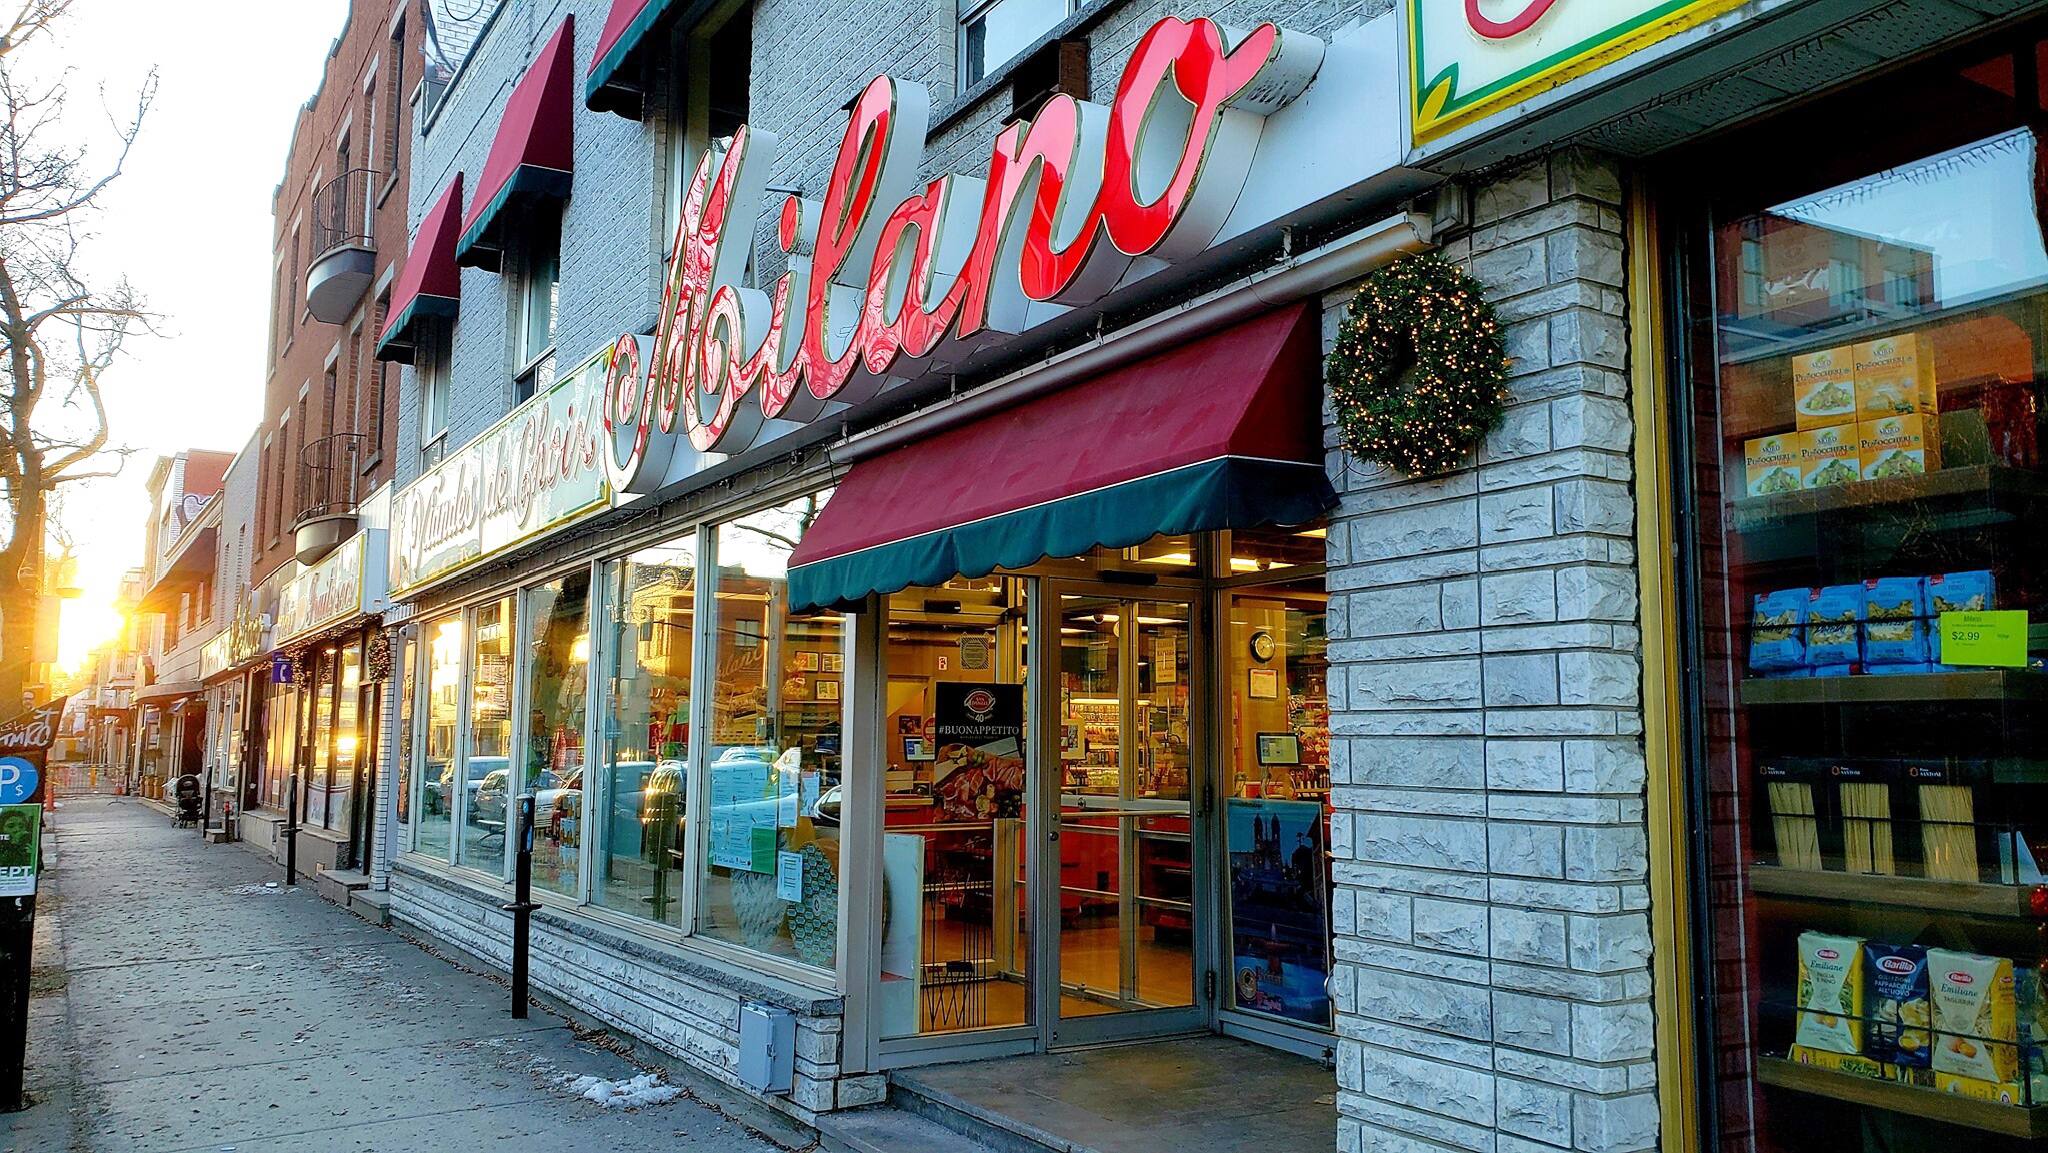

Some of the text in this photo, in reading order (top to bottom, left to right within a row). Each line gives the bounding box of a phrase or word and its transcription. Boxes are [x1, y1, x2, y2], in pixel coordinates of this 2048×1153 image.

[604, 16, 1277, 494] Milano
[513, 392, 599, 530] Choix
[1951, 631, 1980, 641] $2.99
[975, 714, 985, 723] 40
[939, 724, 1020, 735] #BUONAPPETITO
[0, 764, 20, 797] P
[1811, 960, 1844, 971] Emiliane
[1884, 960, 1913, 972] Barilla
[1950, 972, 1972, 981] Barilla
[1941, 983, 1977, 997] Emiliane
